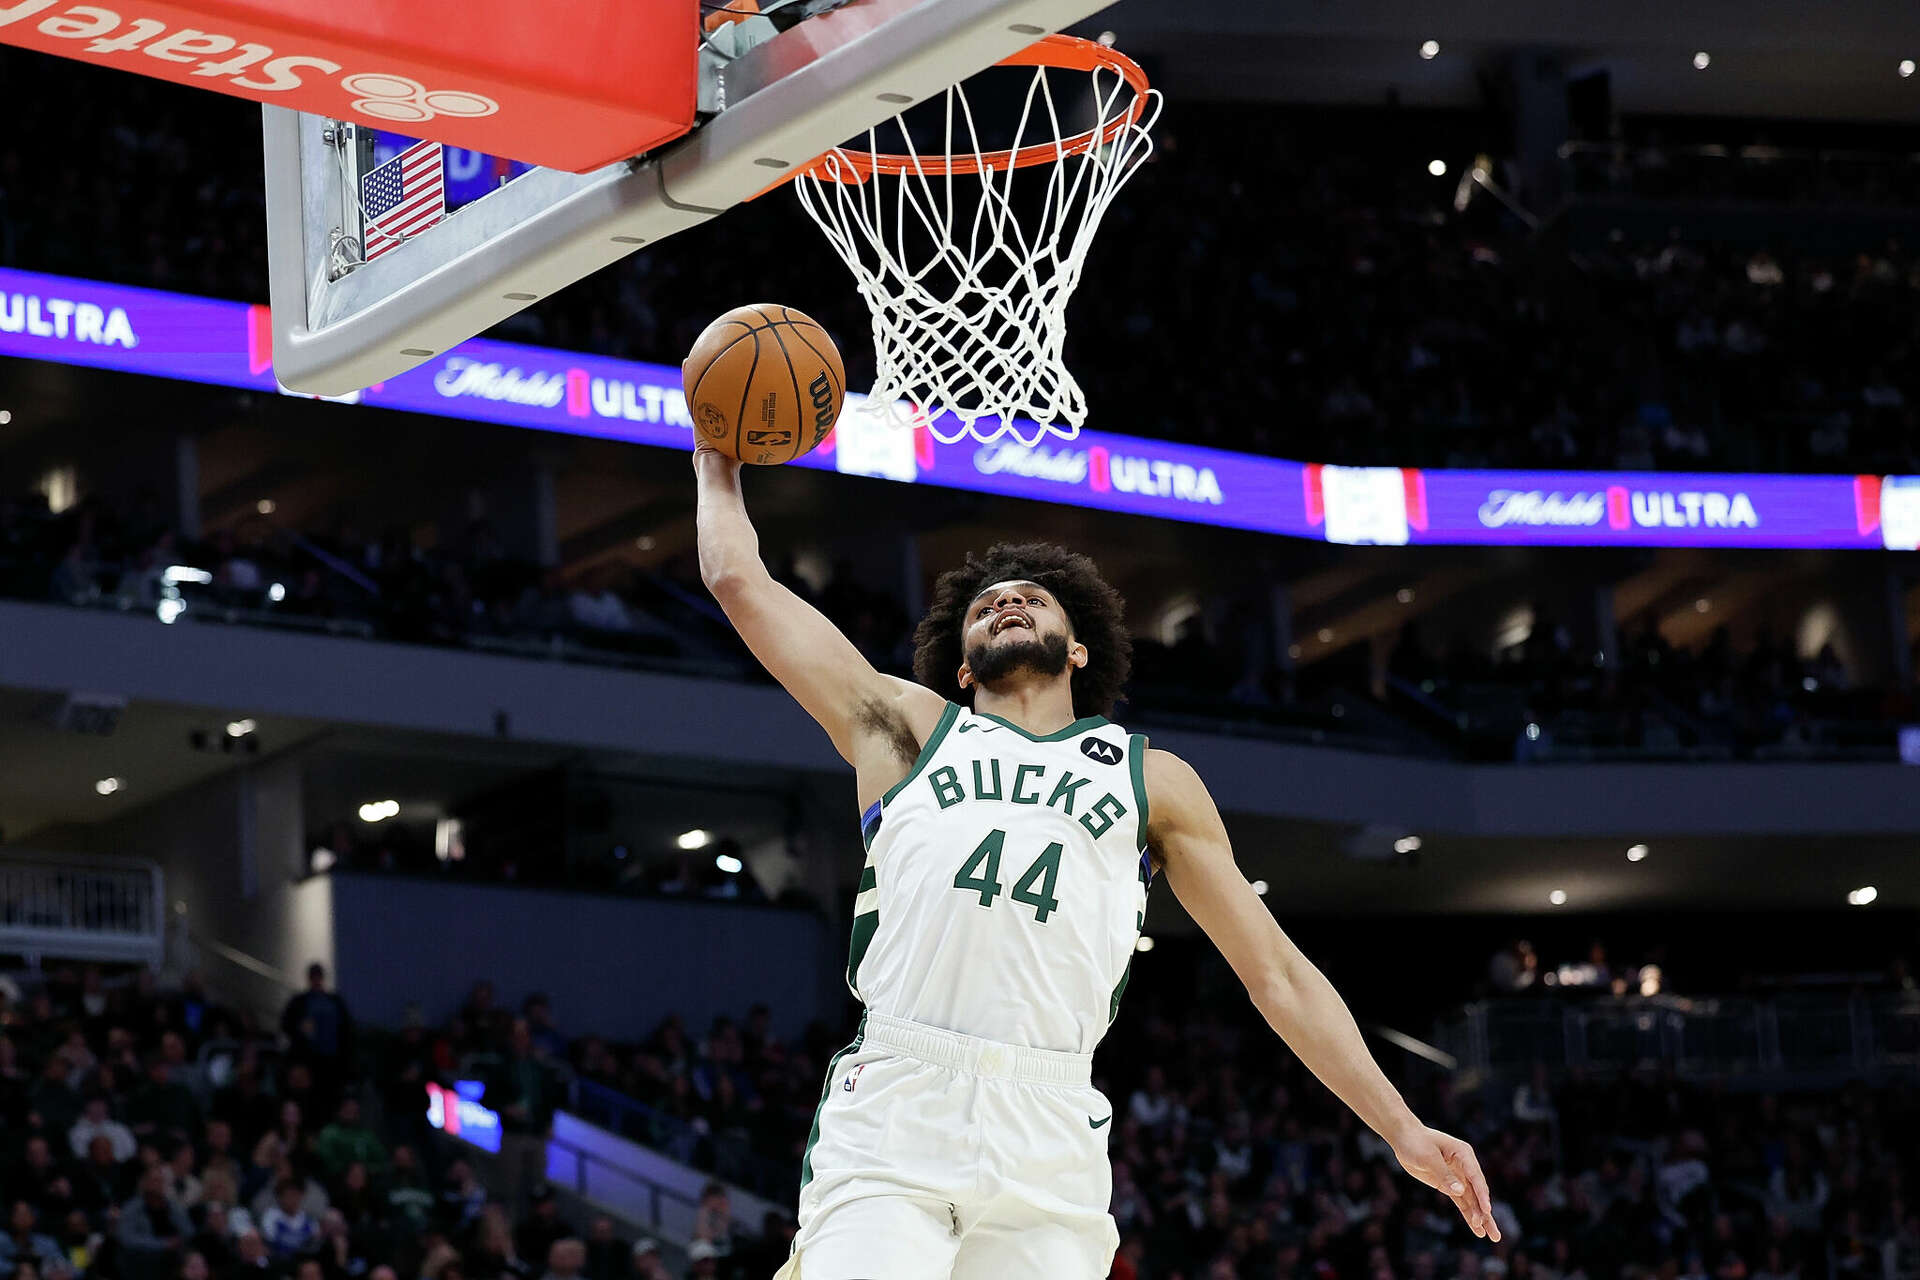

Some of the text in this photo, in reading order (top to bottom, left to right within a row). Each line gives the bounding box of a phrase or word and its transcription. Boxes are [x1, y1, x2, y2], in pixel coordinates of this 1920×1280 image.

[0, 291, 139, 349] ULTRA
[591, 377, 695, 428] ULTR
[1110, 454, 1224, 505] ULTRA
[1632, 491, 1759, 528] ULTRA
[928, 759, 1127, 840] BUCKS
[953, 828, 1063, 924] 44
